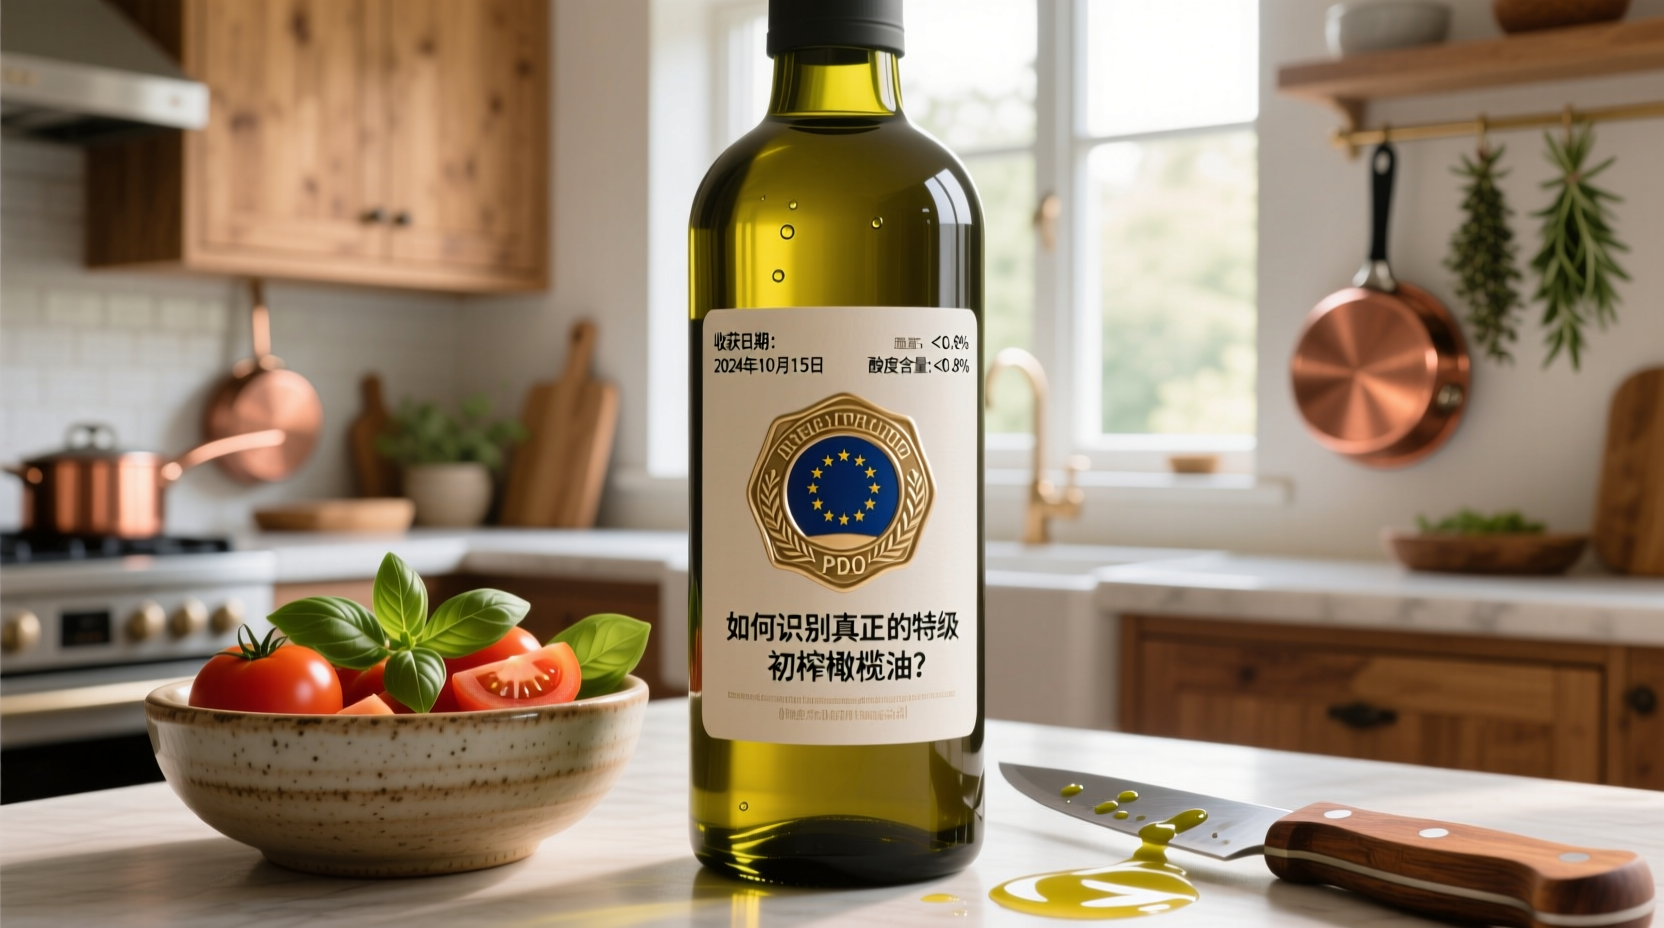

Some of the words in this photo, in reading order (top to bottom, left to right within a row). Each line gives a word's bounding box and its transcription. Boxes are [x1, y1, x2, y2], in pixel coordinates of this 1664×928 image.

[714, 356, 823, 375] 2024年10月15日
[822, 555, 866, 575] PDO
[726, 611, 959, 643] 如何识别真正的特级
[768, 650, 926, 682] 初榨橄榄油?
